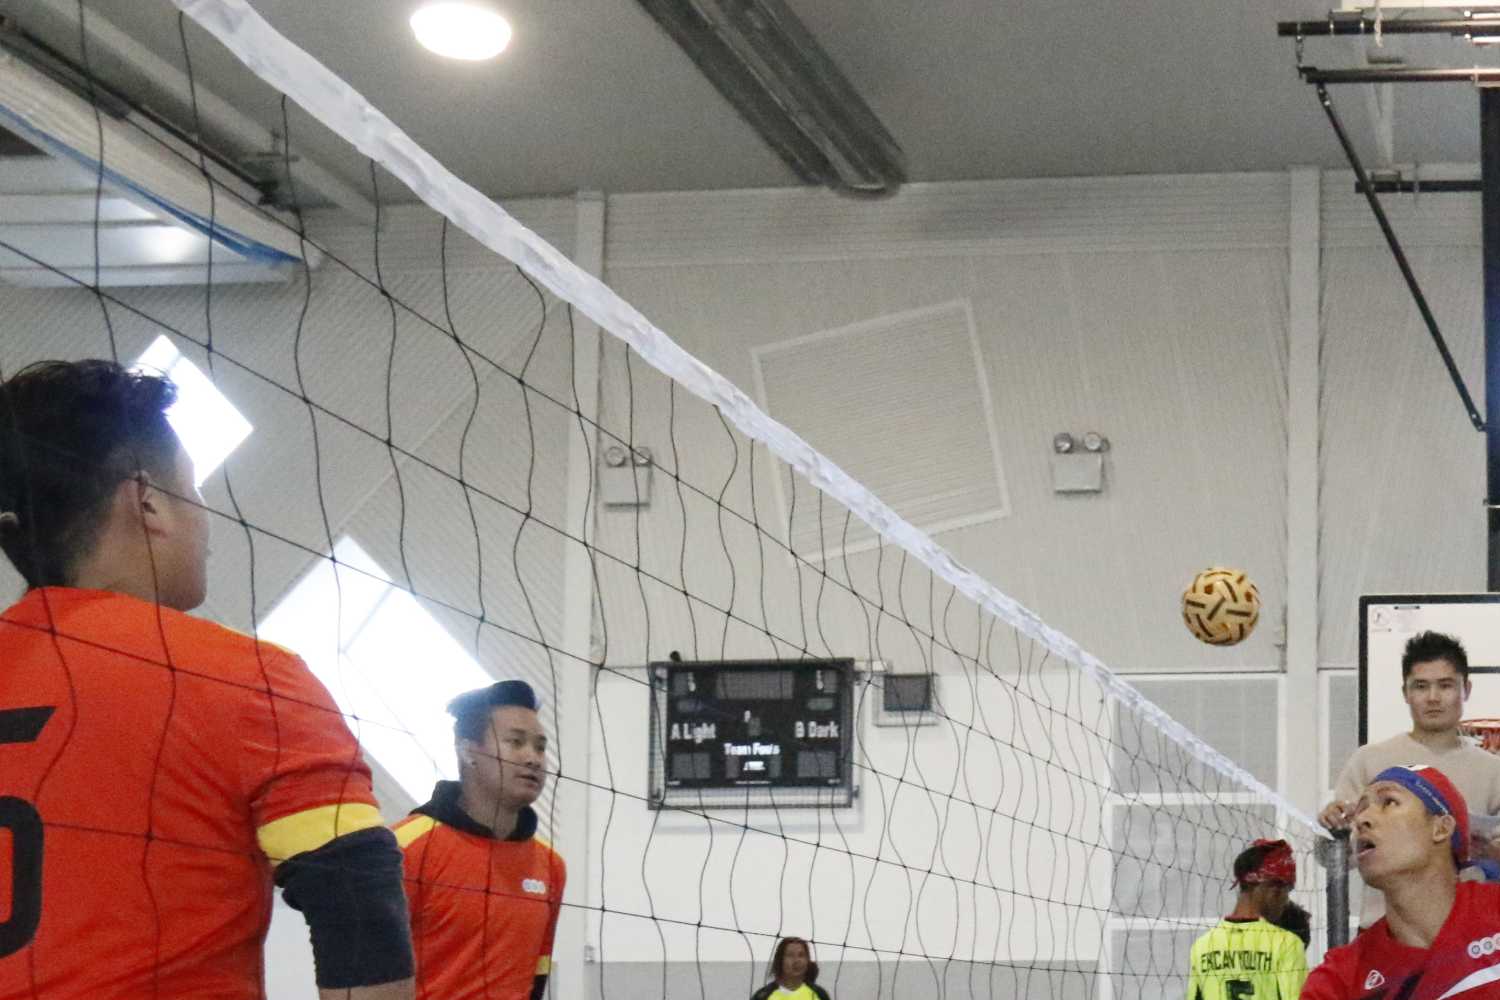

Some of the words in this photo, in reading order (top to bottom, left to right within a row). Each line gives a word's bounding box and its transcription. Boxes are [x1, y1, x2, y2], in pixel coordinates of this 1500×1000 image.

[671, 722, 680, 739] A
[808, 721, 839, 738] Dark
[723, 742, 752, 755] Team
